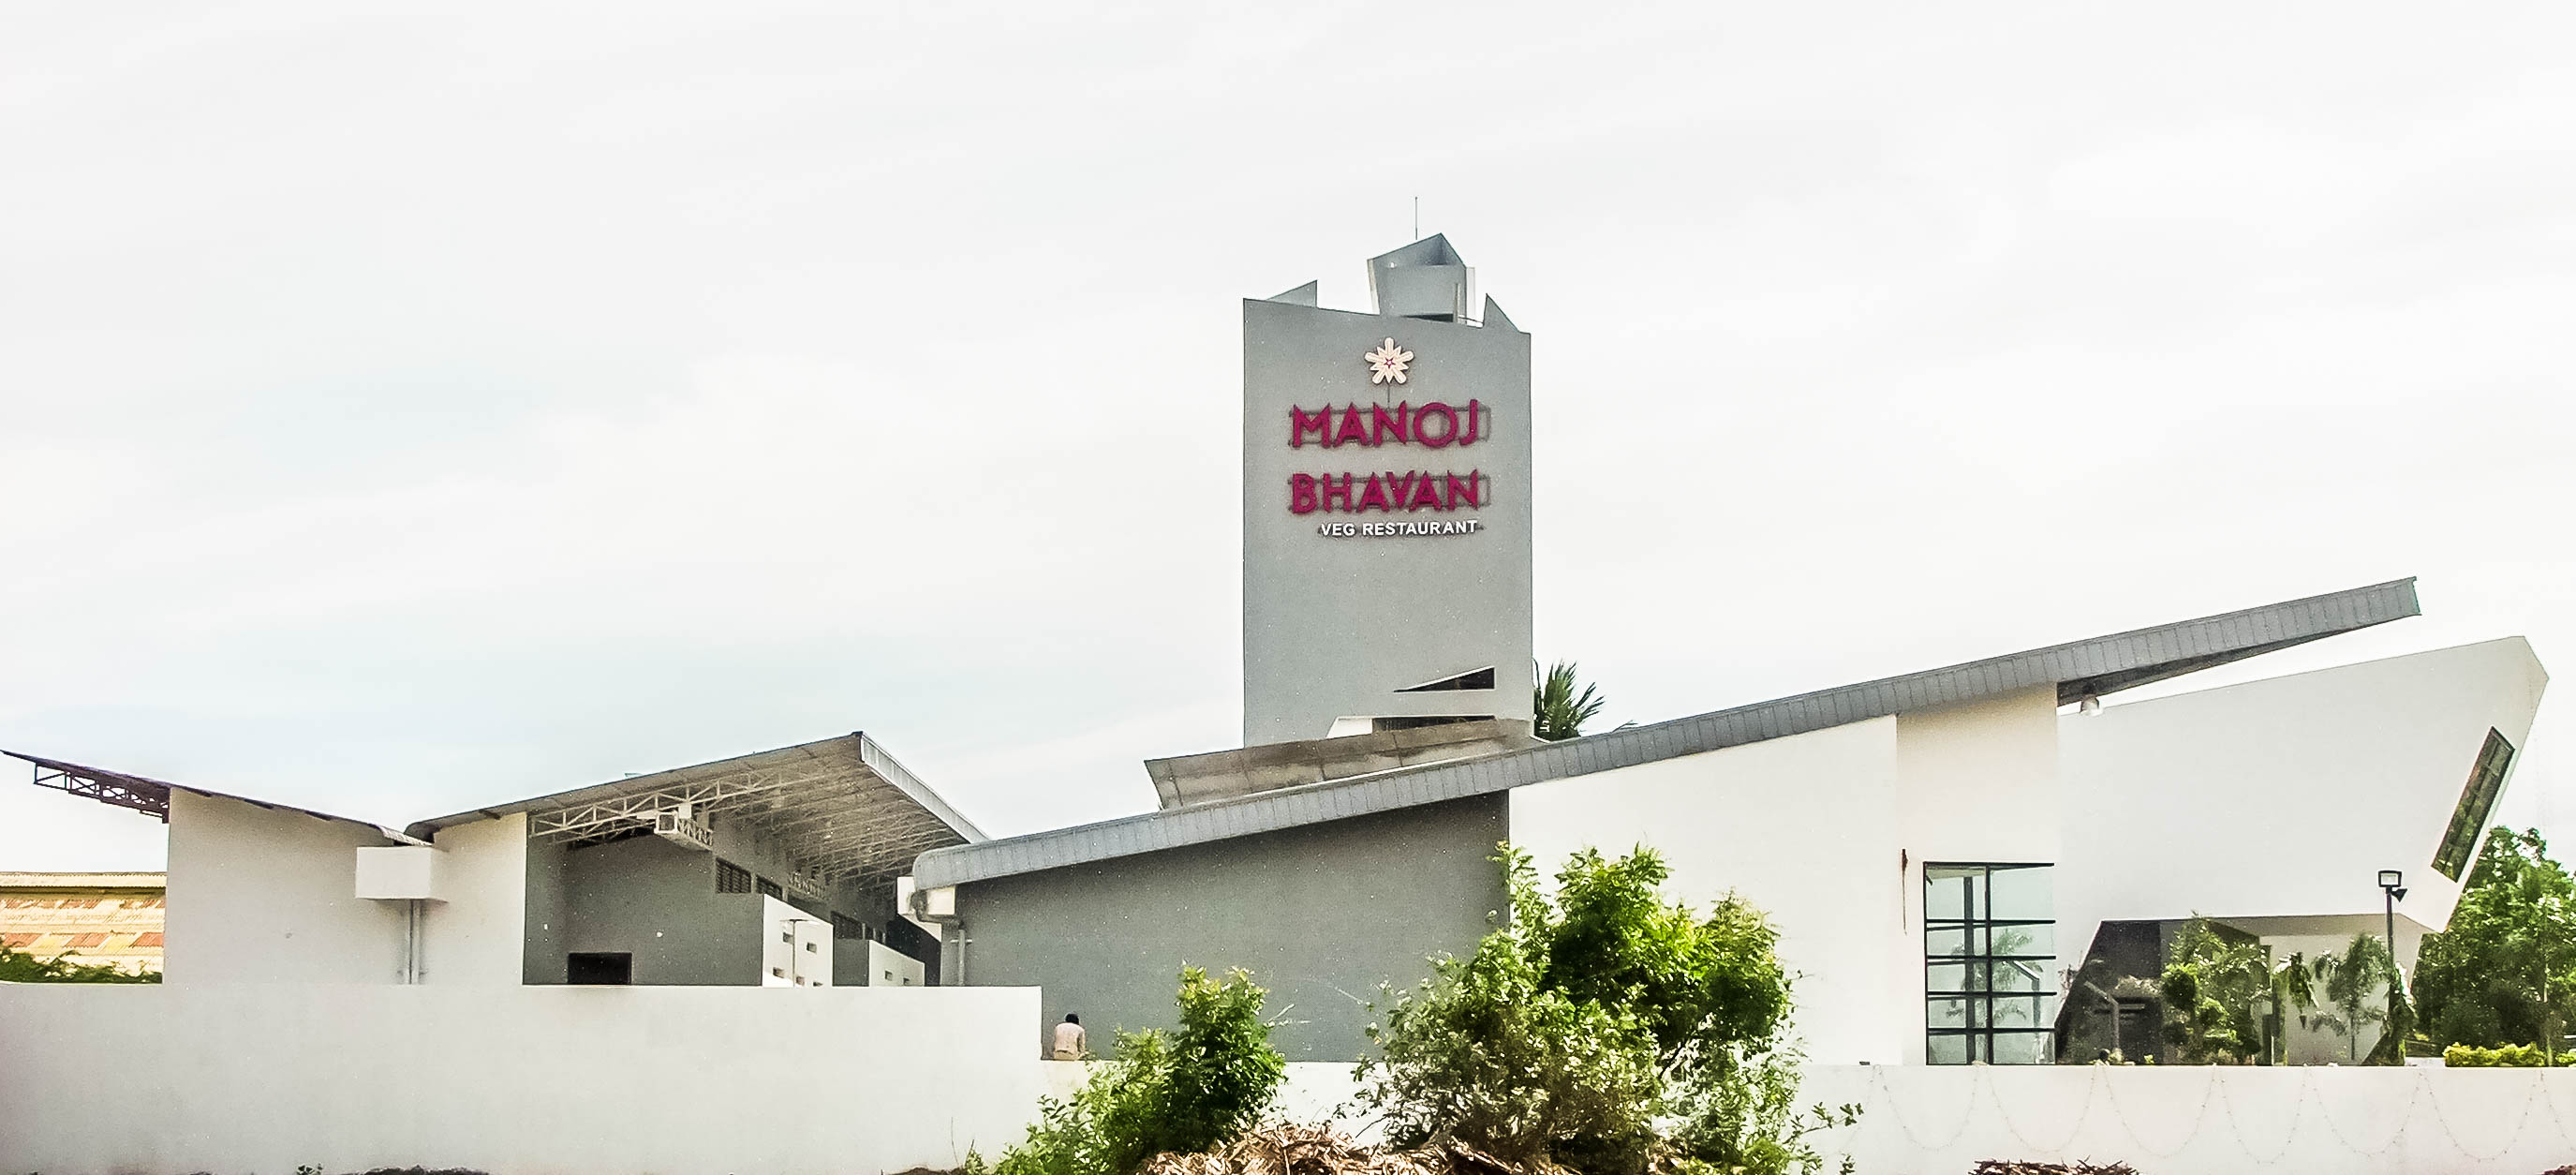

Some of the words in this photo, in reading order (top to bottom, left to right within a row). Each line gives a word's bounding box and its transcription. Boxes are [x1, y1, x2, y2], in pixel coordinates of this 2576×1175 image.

[1292, 398, 1479, 448] MANOJ
[1291, 469, 1478, 513] BHAVAN
[1320, 523, 1355, 537] VEG
[1362, 520, 1478, 536] RESTAURANT
